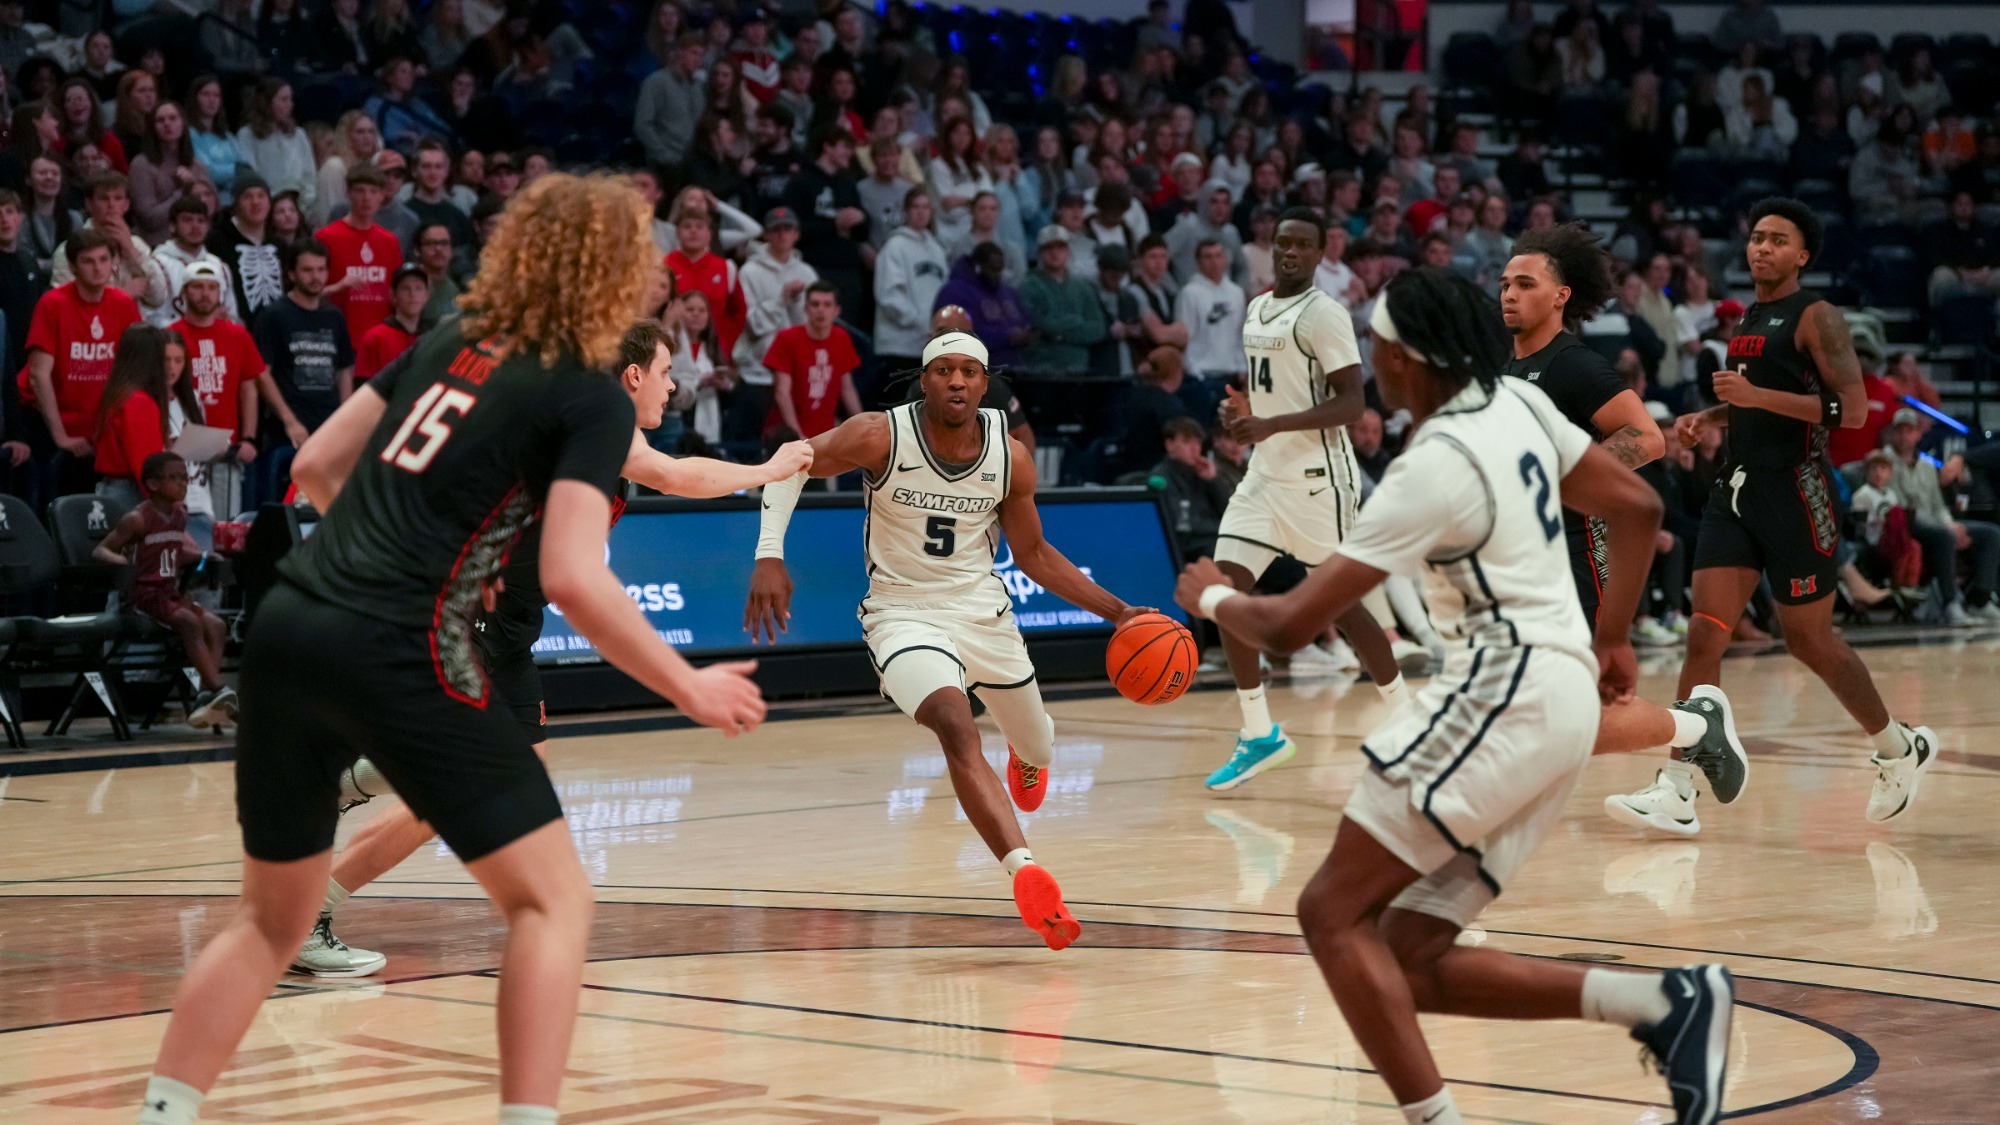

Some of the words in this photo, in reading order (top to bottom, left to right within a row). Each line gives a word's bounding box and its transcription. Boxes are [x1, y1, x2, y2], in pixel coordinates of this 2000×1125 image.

[70, 341, 115, 360] BUCK
[1249, 356, 1273, 393] 14
[380, 382, 478, 475] 15
[892, 488, 995, 513] SAMFORD
[1519, 450, 1561, 542] 2
[923, 516, 957, 557] 5
